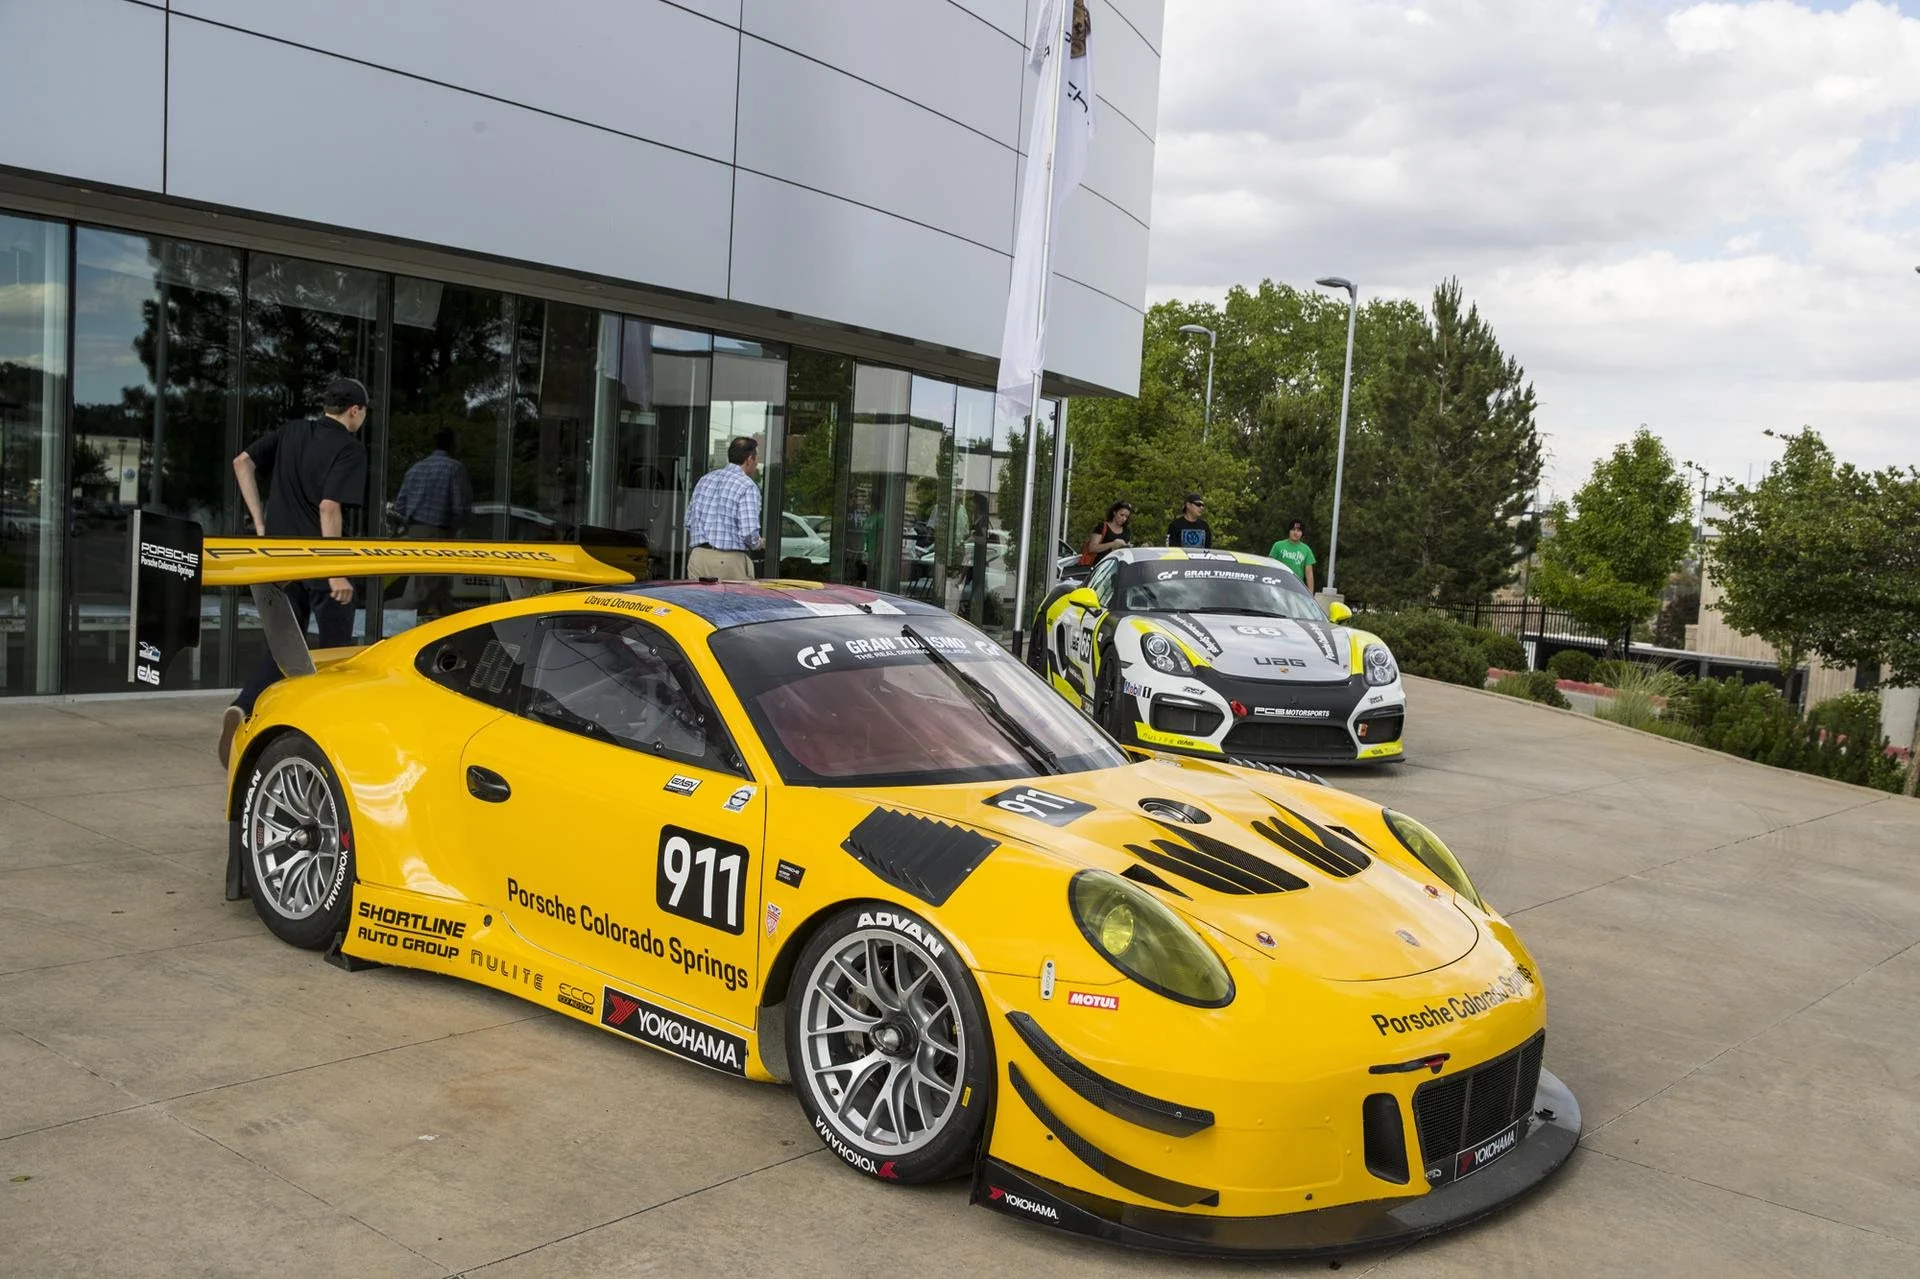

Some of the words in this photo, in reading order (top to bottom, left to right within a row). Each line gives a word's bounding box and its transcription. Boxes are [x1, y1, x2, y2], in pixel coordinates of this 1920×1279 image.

[141, 541, 199, 564] PORSCHE
[204, 547, 362, 559] PCS
[360, 548, 557, 562] MOTORSPORTS
[141, 555, 158, 568] Porsche
[158, 559, 178, 573] Colorado
[177, 563, 195, 579] Springs
[1184, 570, 1211, 578] GRAN
[1213, 570, 1256, 580] TURISMO
[583, 595, 610, 607] David
[610, 598, 653, 613] Donohue
[1237, 625, 1282, 636] 66
[845, 636, 896, 654] GRAN
[895, 635, 967, 650] TUISMO
[855, 653, 874, 661] THE
[875, 651, 899, 659] REAL
[899, 648, 930, 657] DRIVING
[1123, 681, 1142, 697] Mobil
[1254, 707, 1285, 716] PCS
[1286, 709, 1330, 717] MOTORSPORTS
[671, 777, 697, 790] EASY
[242, 769, 262, 848] ADVAN
[998, 789, 1075, 818] 911
[324, 850, 349, 911] YOKOHAMA
[664, 836, 741, 926] 911
[358, 901, 467, 938] SHORTLINE
[358, 926, 398, 947] AUTO
[402, 937, 460, 959] GROUP
[508, 878, 577, 925] Porsche
[580, 904, 665, 958] Colorado
[669, 937, 749, 991] Springs
[857, 912, 944, 958] ADVAN
[559, 983, 595, 1005] ECO
[1070, 993, 1117, 1009] MOTUL
[1371, 1005, 1454, 1036] Porsche
[1448, 983, 1509, 1018] Colorado
[638, 1008, 739, 1068] YOKOHAMA
[815, 1115, 878, 1174] YOKOHAMA
[1475, 1130, 1514, 1165] YOKOHAMA
[1004, 1192, 1058, 1219] YOKOHAMA
